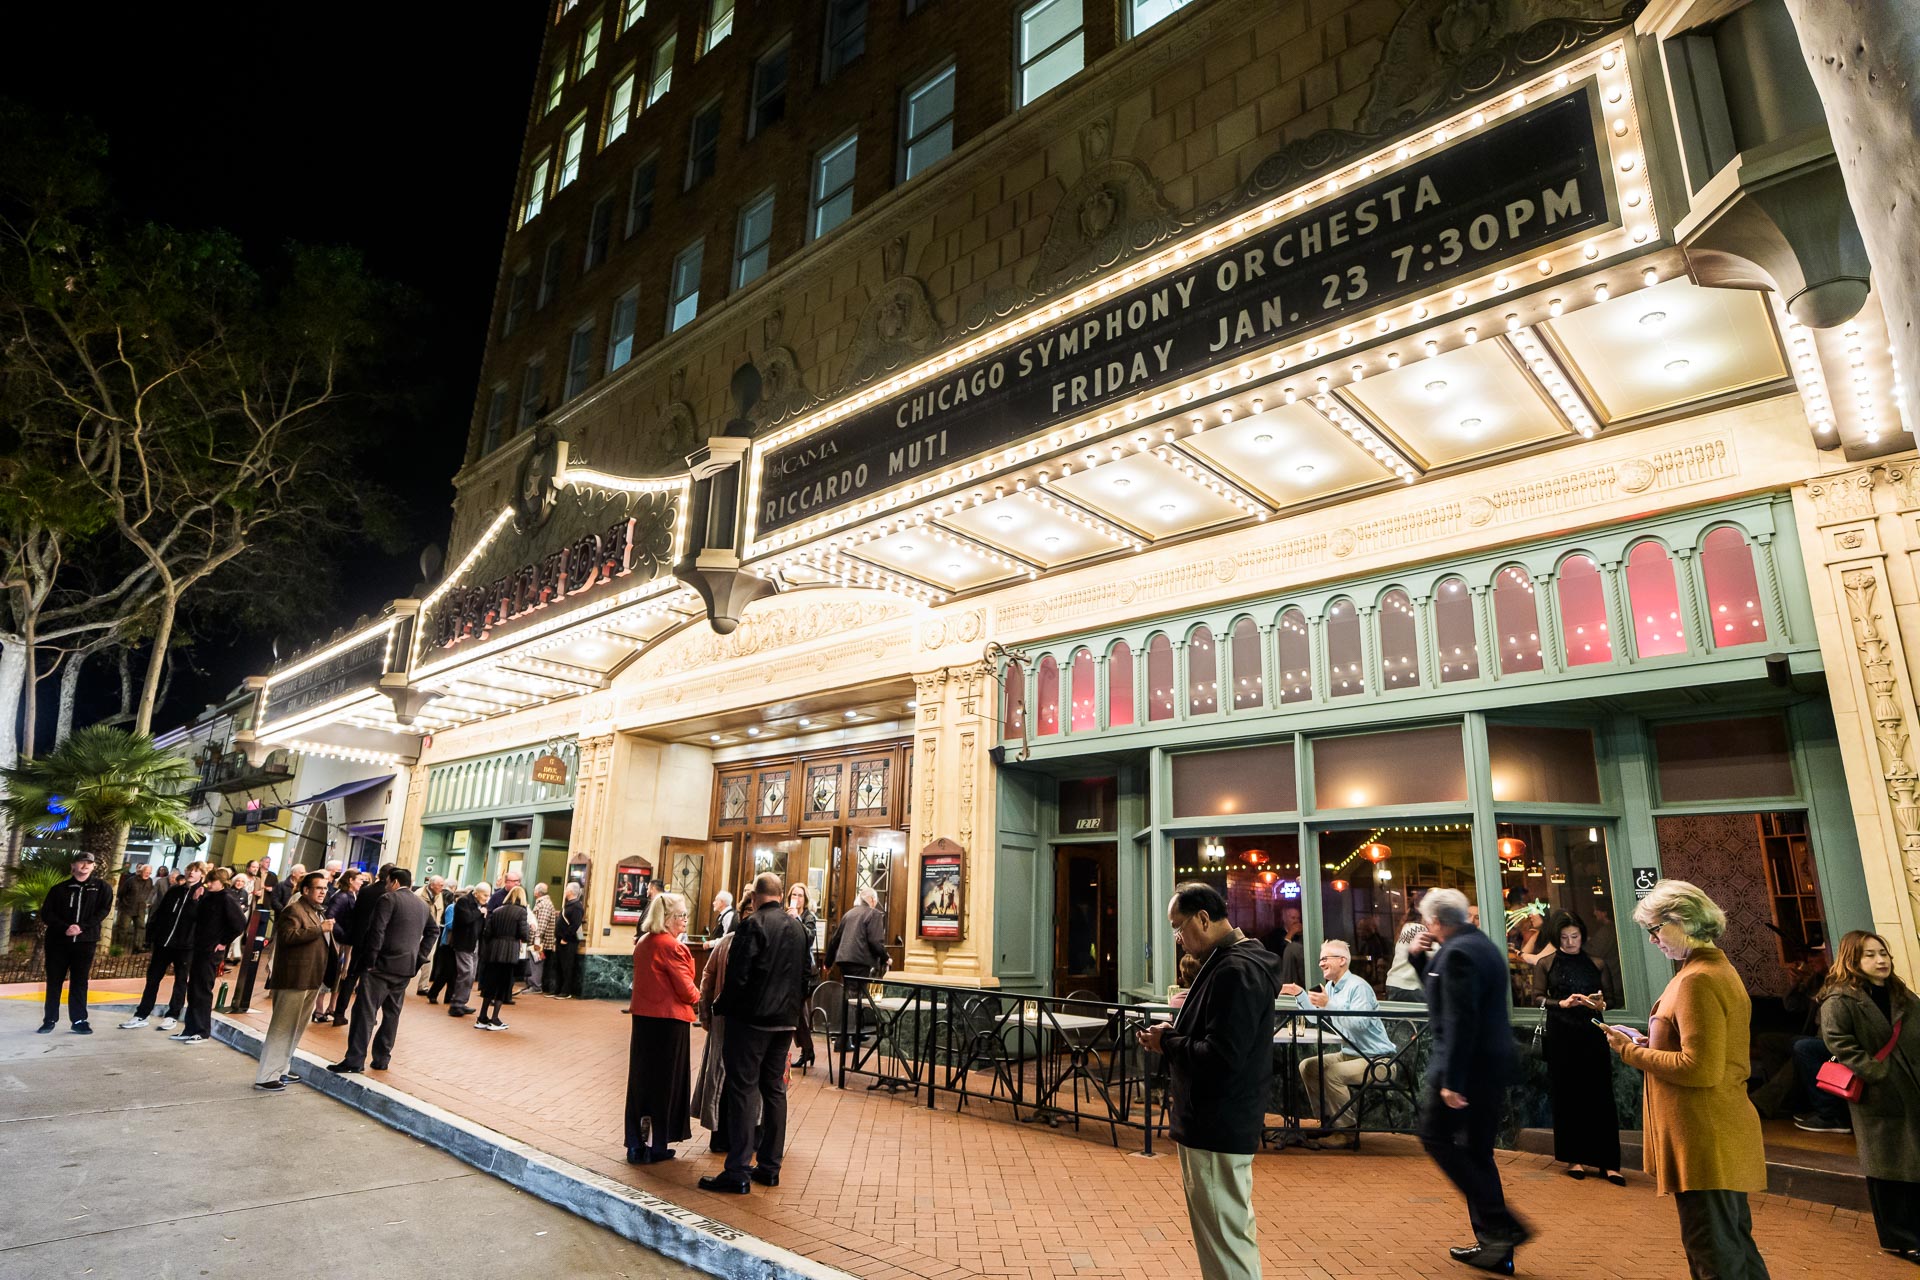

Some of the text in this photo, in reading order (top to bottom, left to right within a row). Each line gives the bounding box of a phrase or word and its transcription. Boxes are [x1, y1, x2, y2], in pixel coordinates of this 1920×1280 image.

[896, 175, 1442, 428] CHICAGO SYMPHONY ORCHESTA
[1051, 178, 1583, 413] FRIDAY JAN. 23 7:30PM
[783, 440, 838, 474] CAMA
[765, 430, 947, 524] RICCARDO MUTI
[537, 772, 562, 781] OFFICE
[543, 766, 558, 774] BOX
[1078, 819, 1099, 829] 1212
[642, 1199, 668, 1207] AT
[658, 1207, 693, 1220] ALL
[693, 1219, 744, 1241] TIMES
